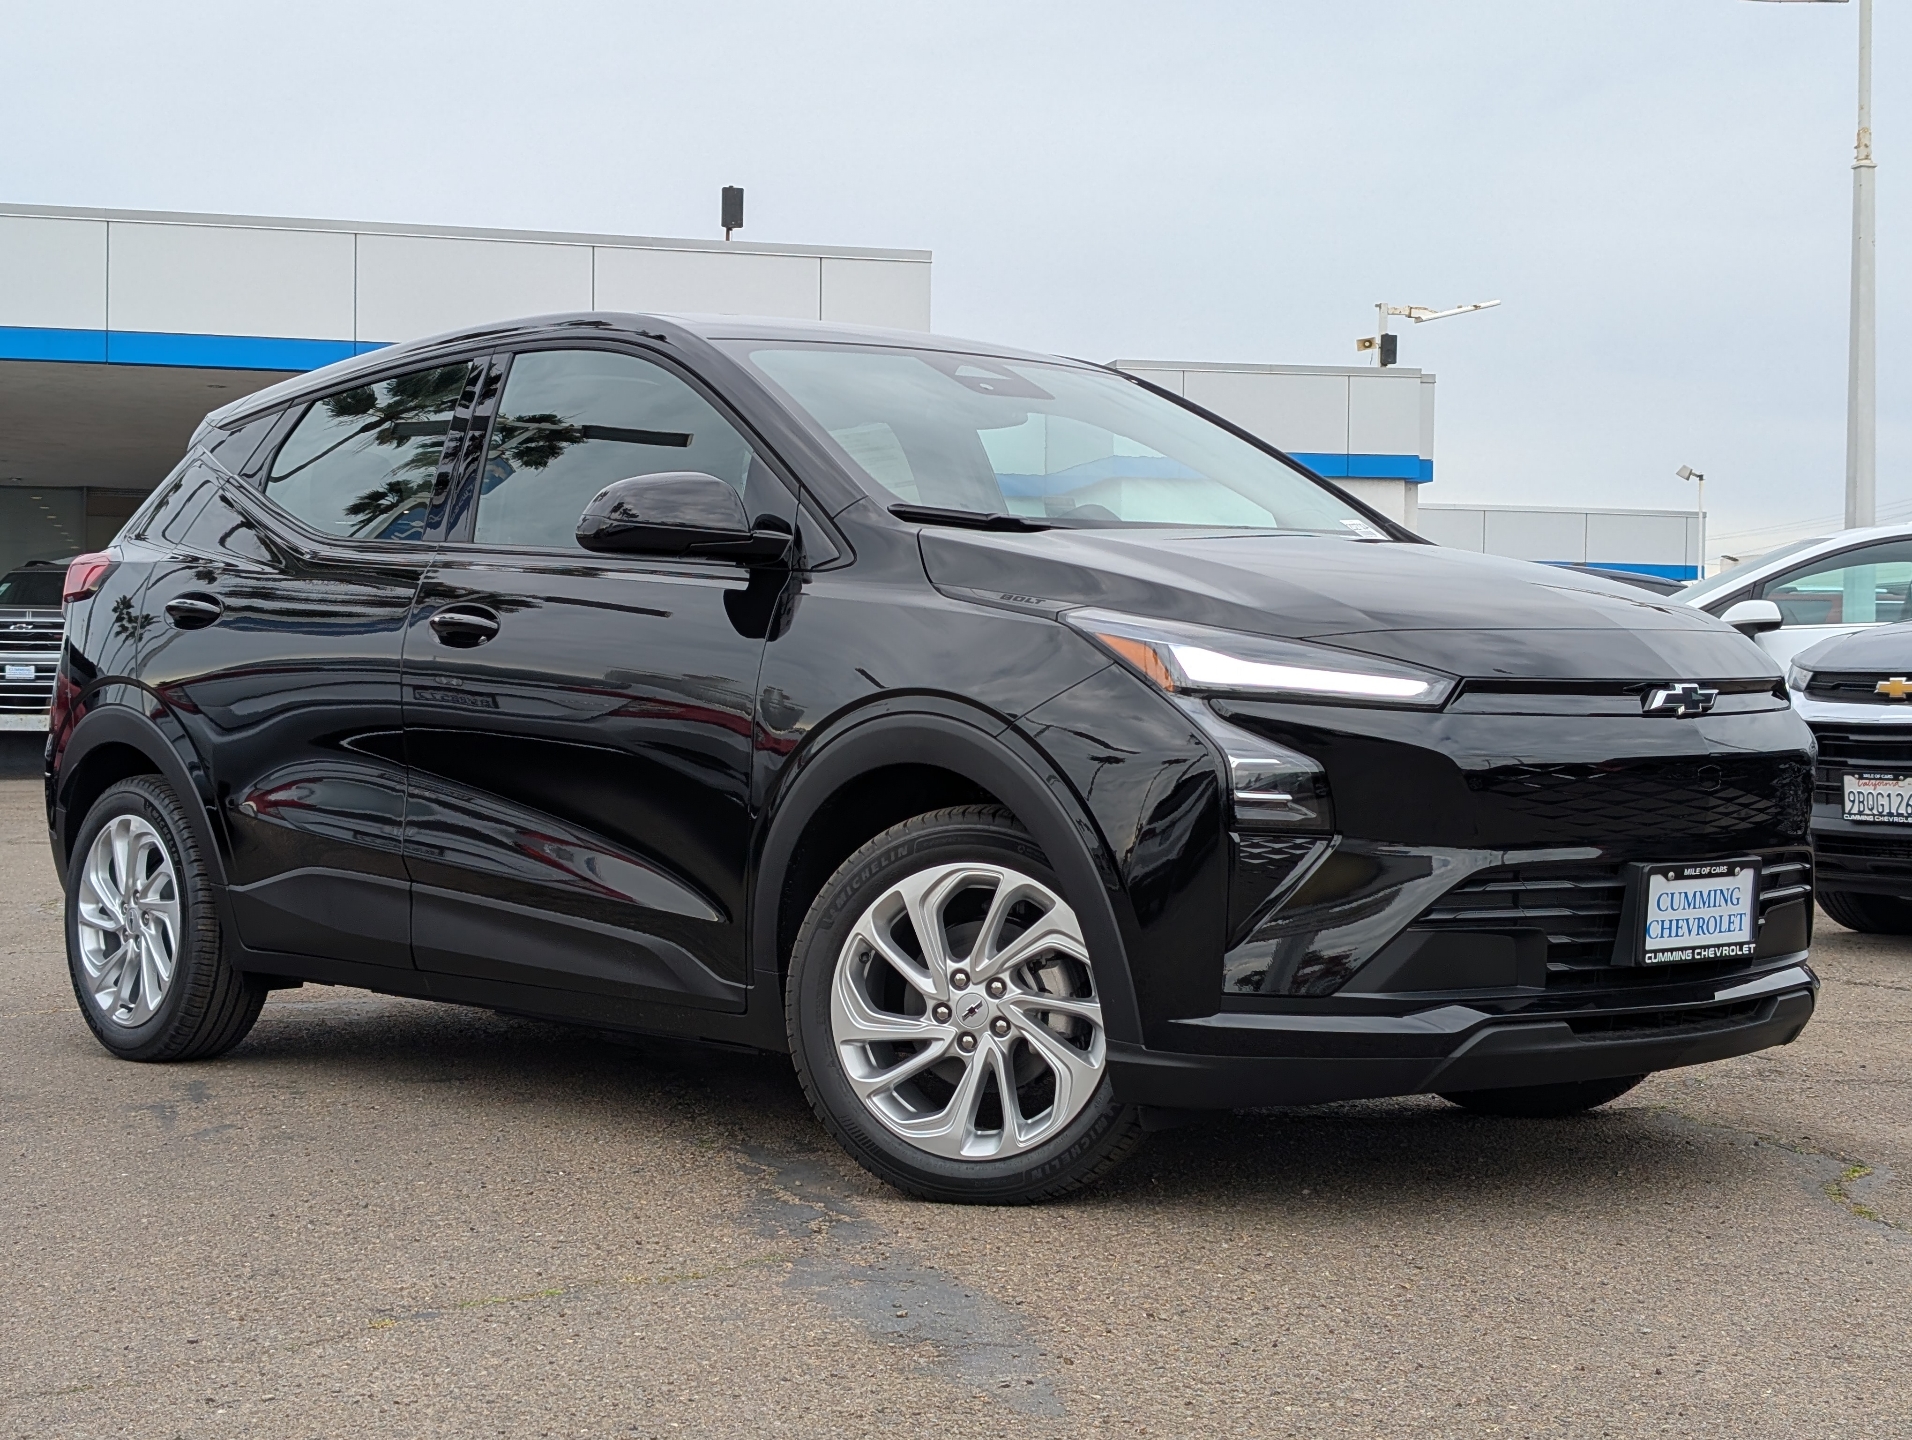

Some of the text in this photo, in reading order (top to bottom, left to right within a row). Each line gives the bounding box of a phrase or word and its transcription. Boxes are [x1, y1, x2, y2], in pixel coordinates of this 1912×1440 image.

[1000, 593, 1046, 604] BOLT
[1857, 779, 1905, 790] California
[1848, 790, 1912, 815] 9BQG126
[834, 845, 909, 908] MICHELIN
[1683, 866, 1728, 876] MILE OF CARS
[1656, 886, 1741, 912] CUMMING
[1647, 912, 1746, 940] CHEVROLET
[1645, 943, 1756, 963] CUMMING CHEVROLET
[1031, 1116, 1109, 1181] MICHELIN
